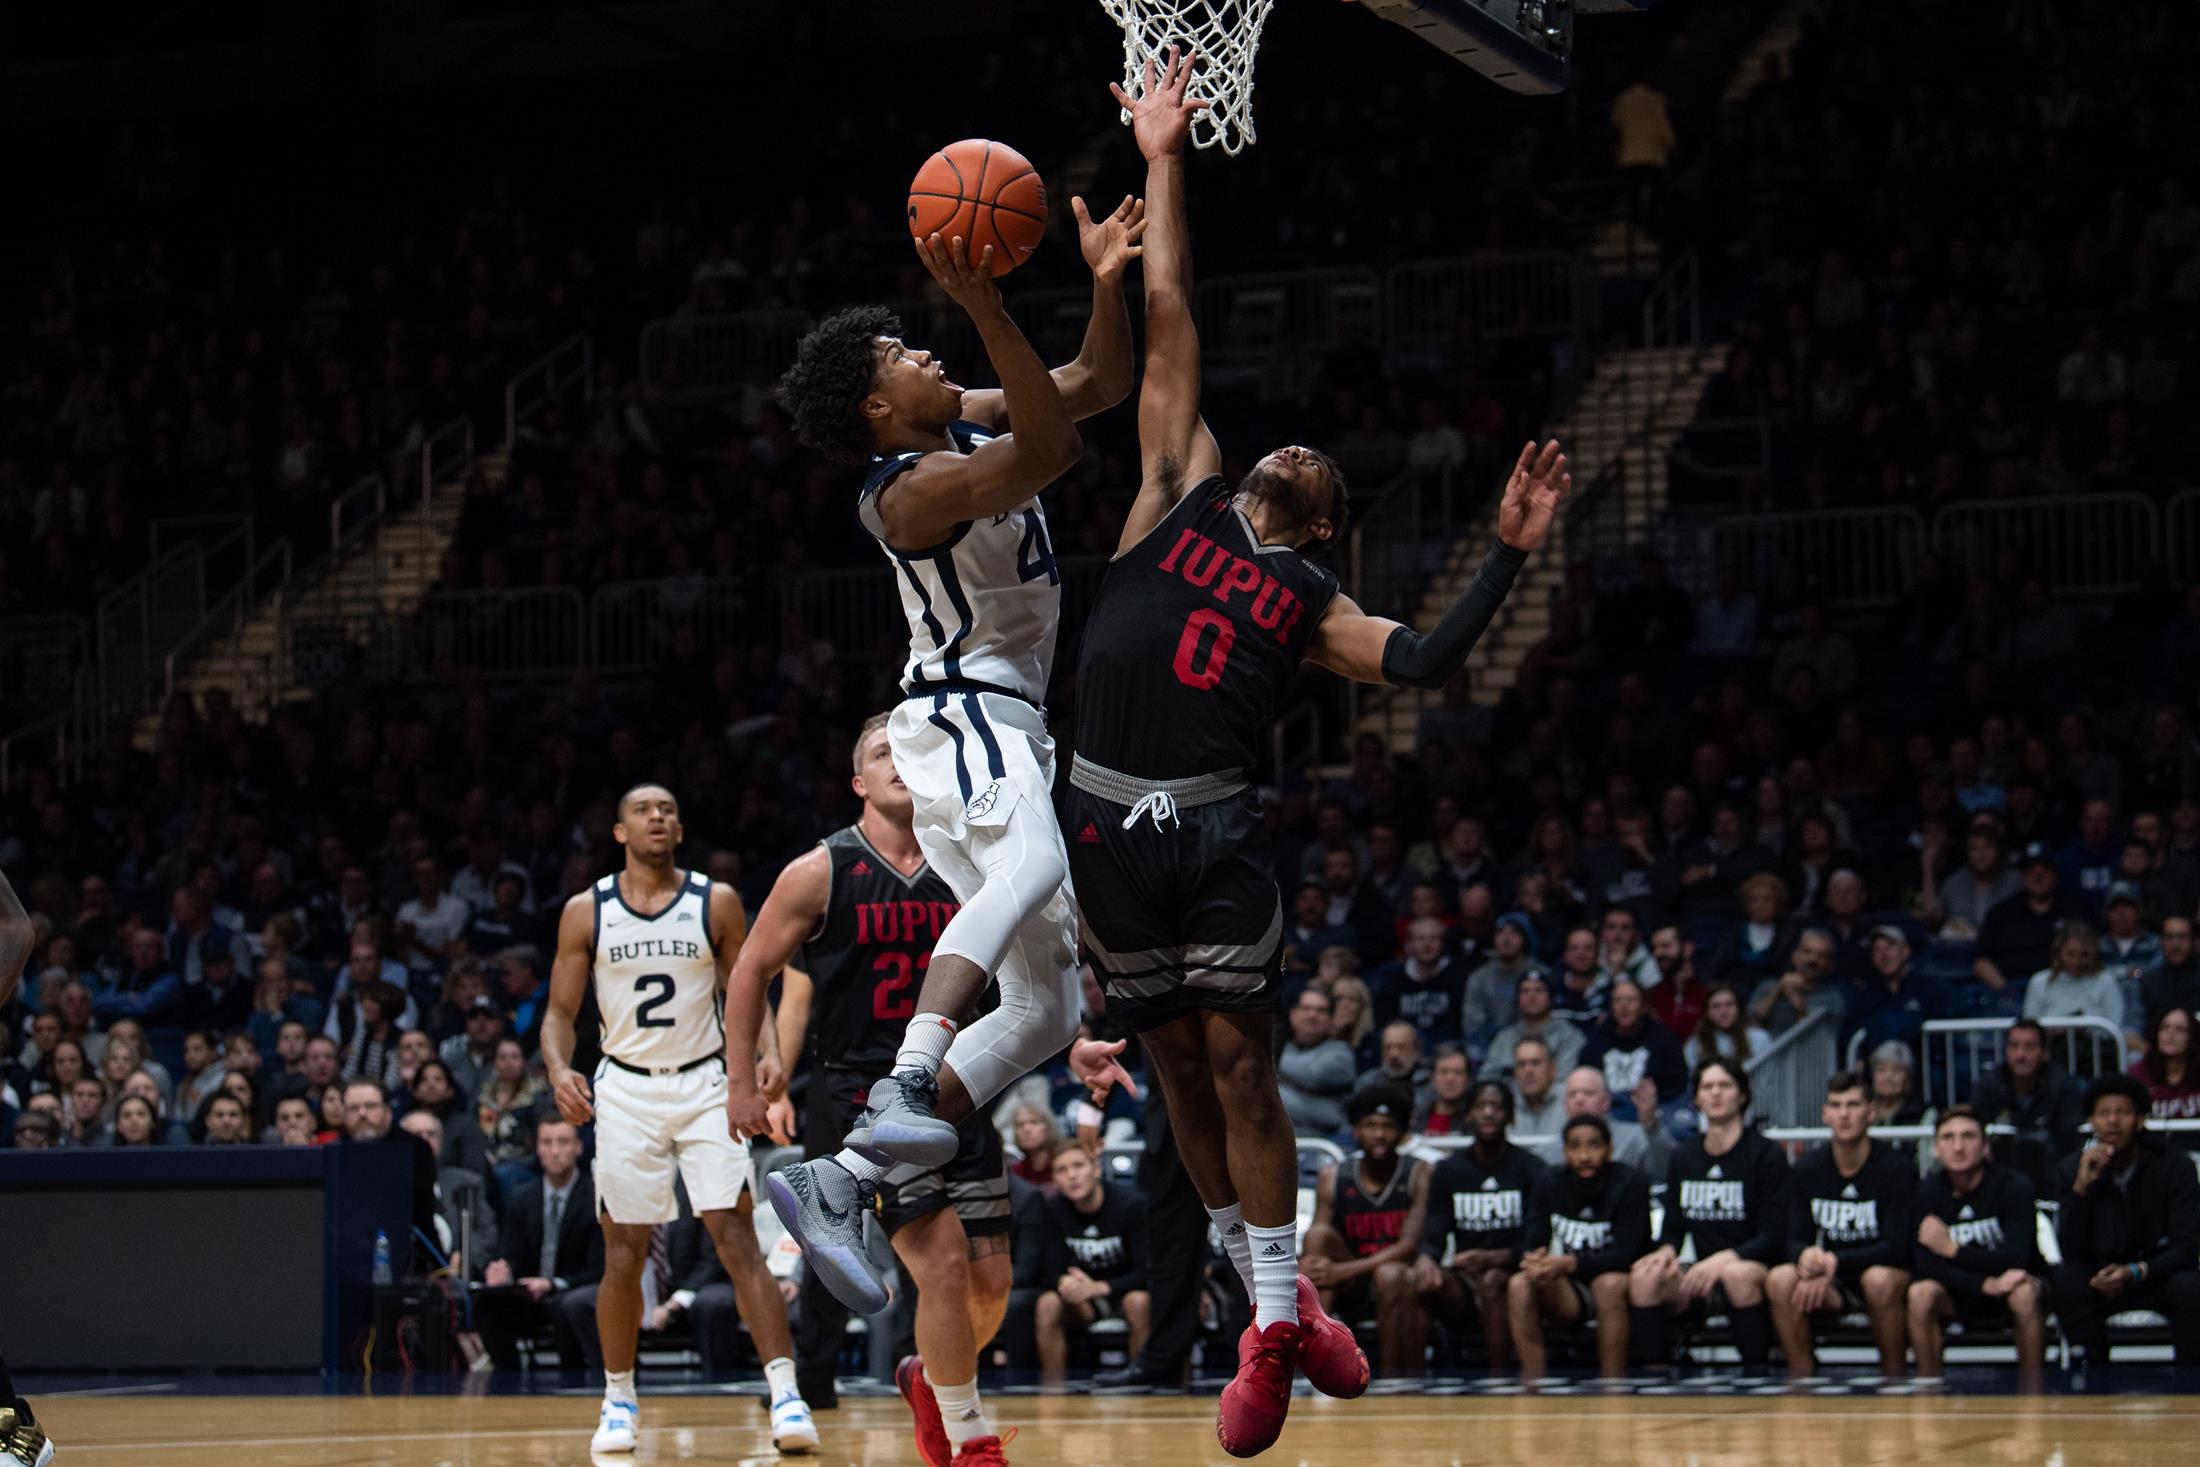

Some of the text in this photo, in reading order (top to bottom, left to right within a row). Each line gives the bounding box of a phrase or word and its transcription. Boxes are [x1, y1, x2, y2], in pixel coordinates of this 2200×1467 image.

[1017, 507, 1059, 587] 4
[1158, 528, 1307, 647] IUPUI
[1173, 608, 1237, 691] 0
[855, 900, 961, 945] IUPU
[609, 940, 700, 963] BUTLER
[634, 974, 676, 1028] 2
[872, 951, 932, 1021] 2
[1451, 1189, 1523, 1220] IUPUI
[1680, 1179, 1746, 1210] IUPUI
[1810, 1198, 1879, 1230] IUPUI
